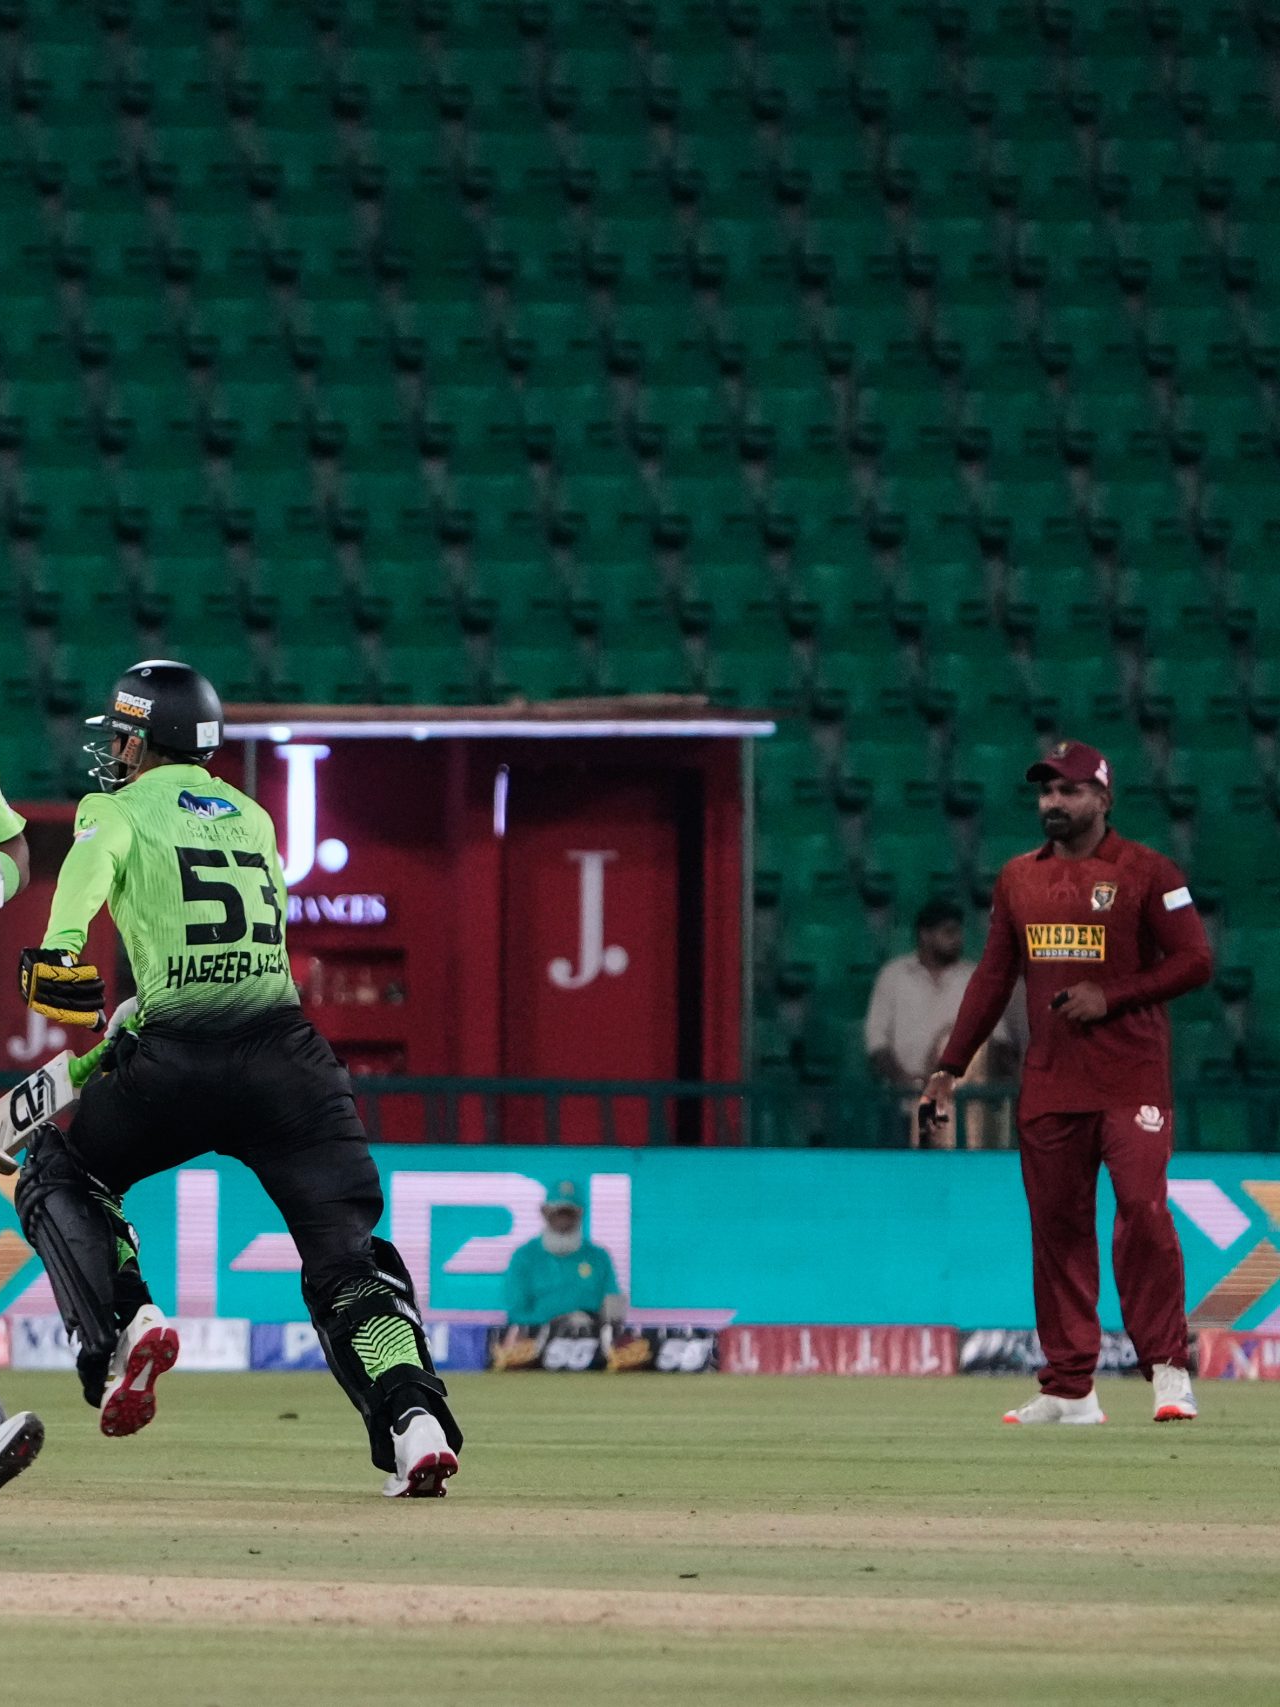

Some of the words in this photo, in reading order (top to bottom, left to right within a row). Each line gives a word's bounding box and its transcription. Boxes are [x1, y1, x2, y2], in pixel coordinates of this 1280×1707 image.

[174, 846, 282, 946] 53
[1027, 926, 1104, 946] WISDEN
[1035, 949, 1097, 957] WISDEN.COM
